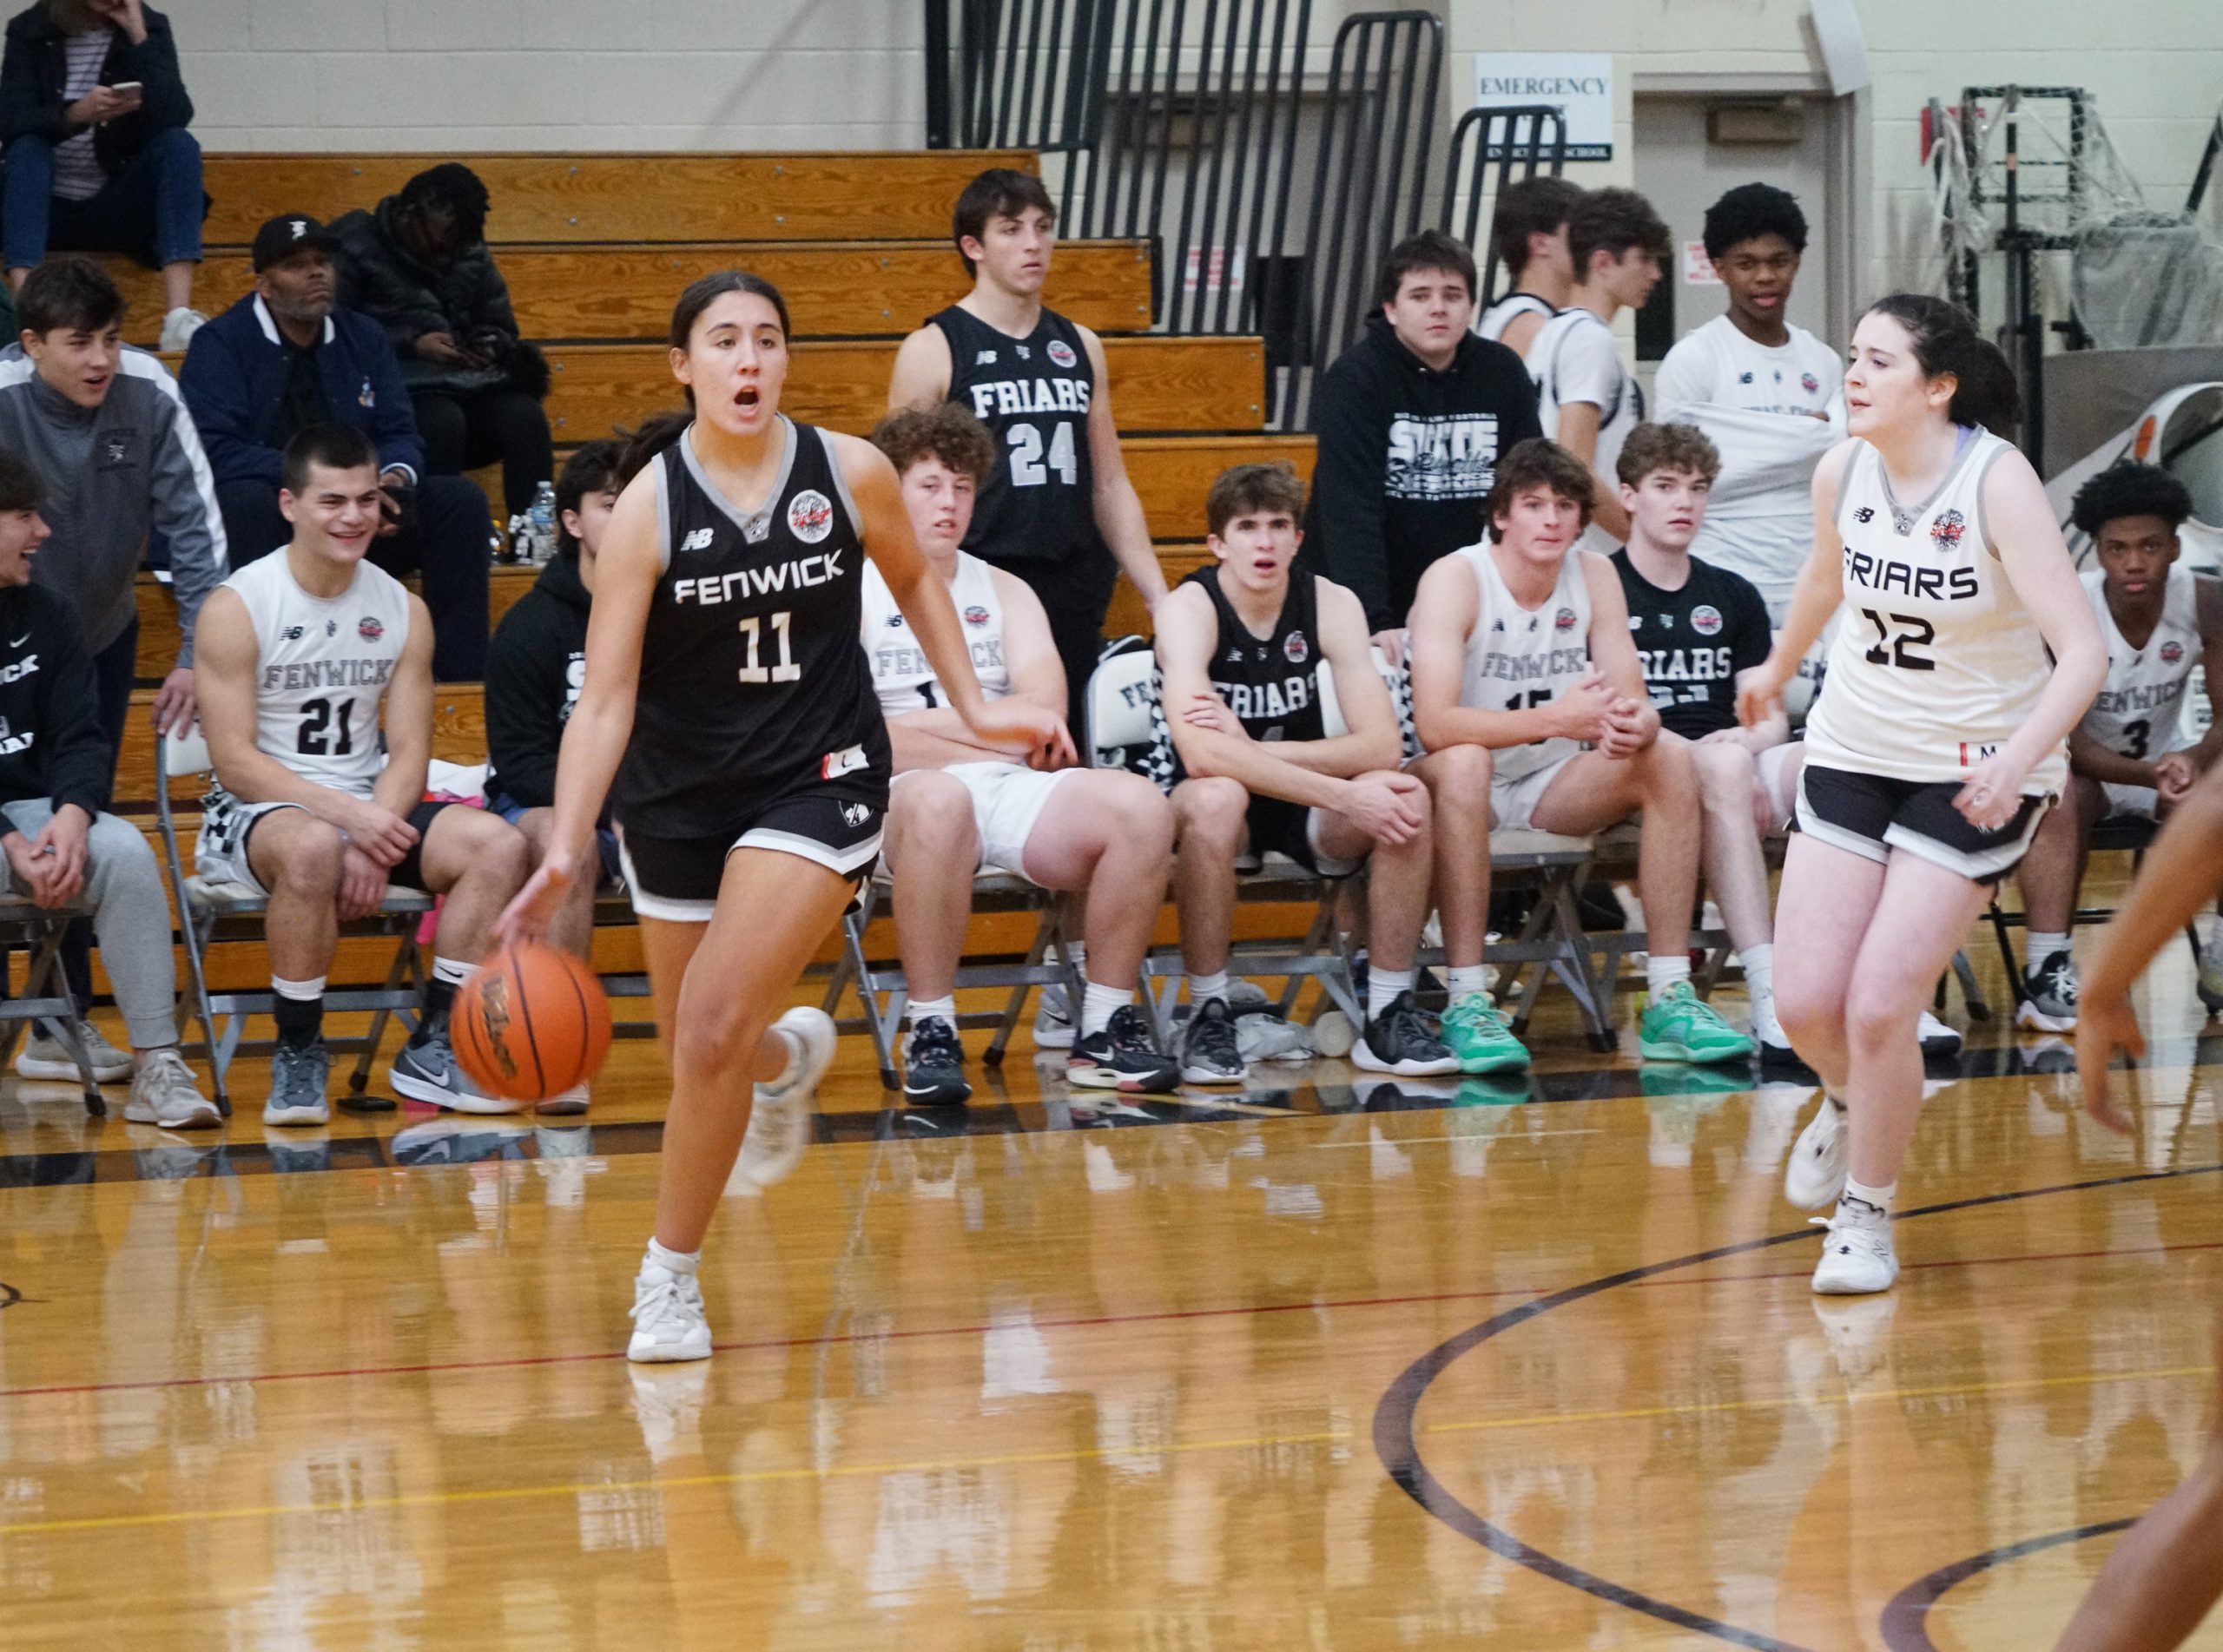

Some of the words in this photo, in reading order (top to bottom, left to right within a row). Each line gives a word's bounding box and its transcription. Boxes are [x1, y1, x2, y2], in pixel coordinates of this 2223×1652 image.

[1480, 77, 1607, 95] EMERGENCY
[970, 378, 1091, 419] FRIARS
[1006, 421, 1077, 487] 24
[674, 549, 845, 606] FENWICK
[739, 611, 801, 683] 11
[875, 640, 1004, 677] FENCK
[1861, 608, 1936, 671] 12
[263, 659, 395, 689] FENWICK
[1637, 647, 1732, 680] RIARS
[298, 698, 357, 755] 21
[2119, 720, 2151, 760] 3
